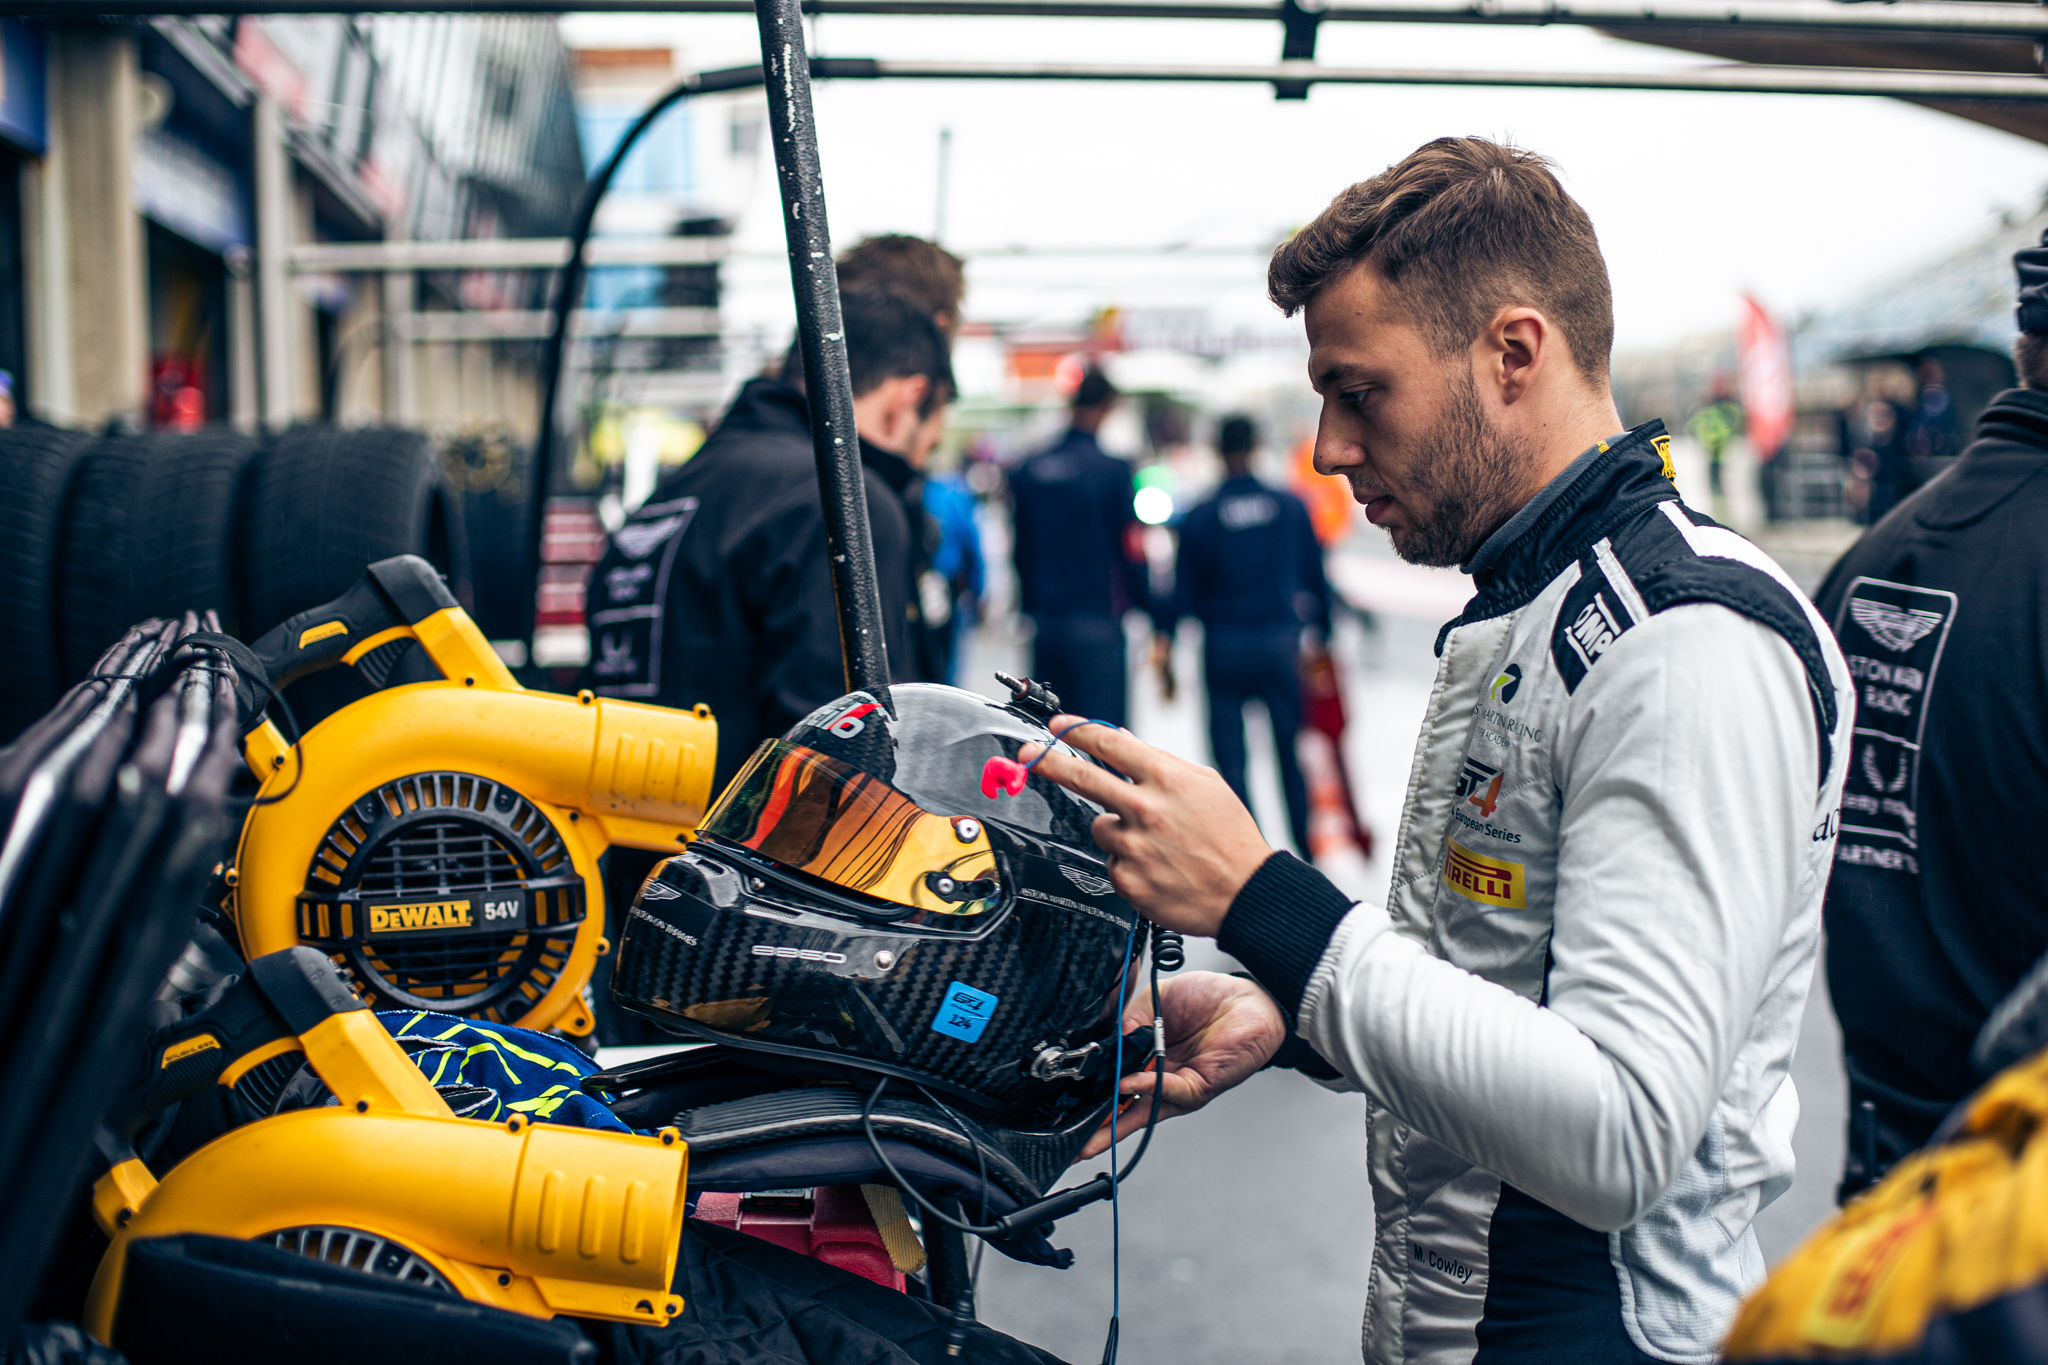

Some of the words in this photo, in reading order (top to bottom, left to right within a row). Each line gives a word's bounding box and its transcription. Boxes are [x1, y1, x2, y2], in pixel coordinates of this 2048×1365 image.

[1572, 602, 1613, 657] OMP
[1455, 807, 1484, 833] European
[1484, 823, 1522, 844] Series
[1444, 844, 1512, 899] PIRELLI
[484, 900, 519, 921] 54V
[953, 992, 986, 1011] GT4
[1413, 1243, 1426, 1264] M.
[1429, 1250, 1473, 1285] Cowley
